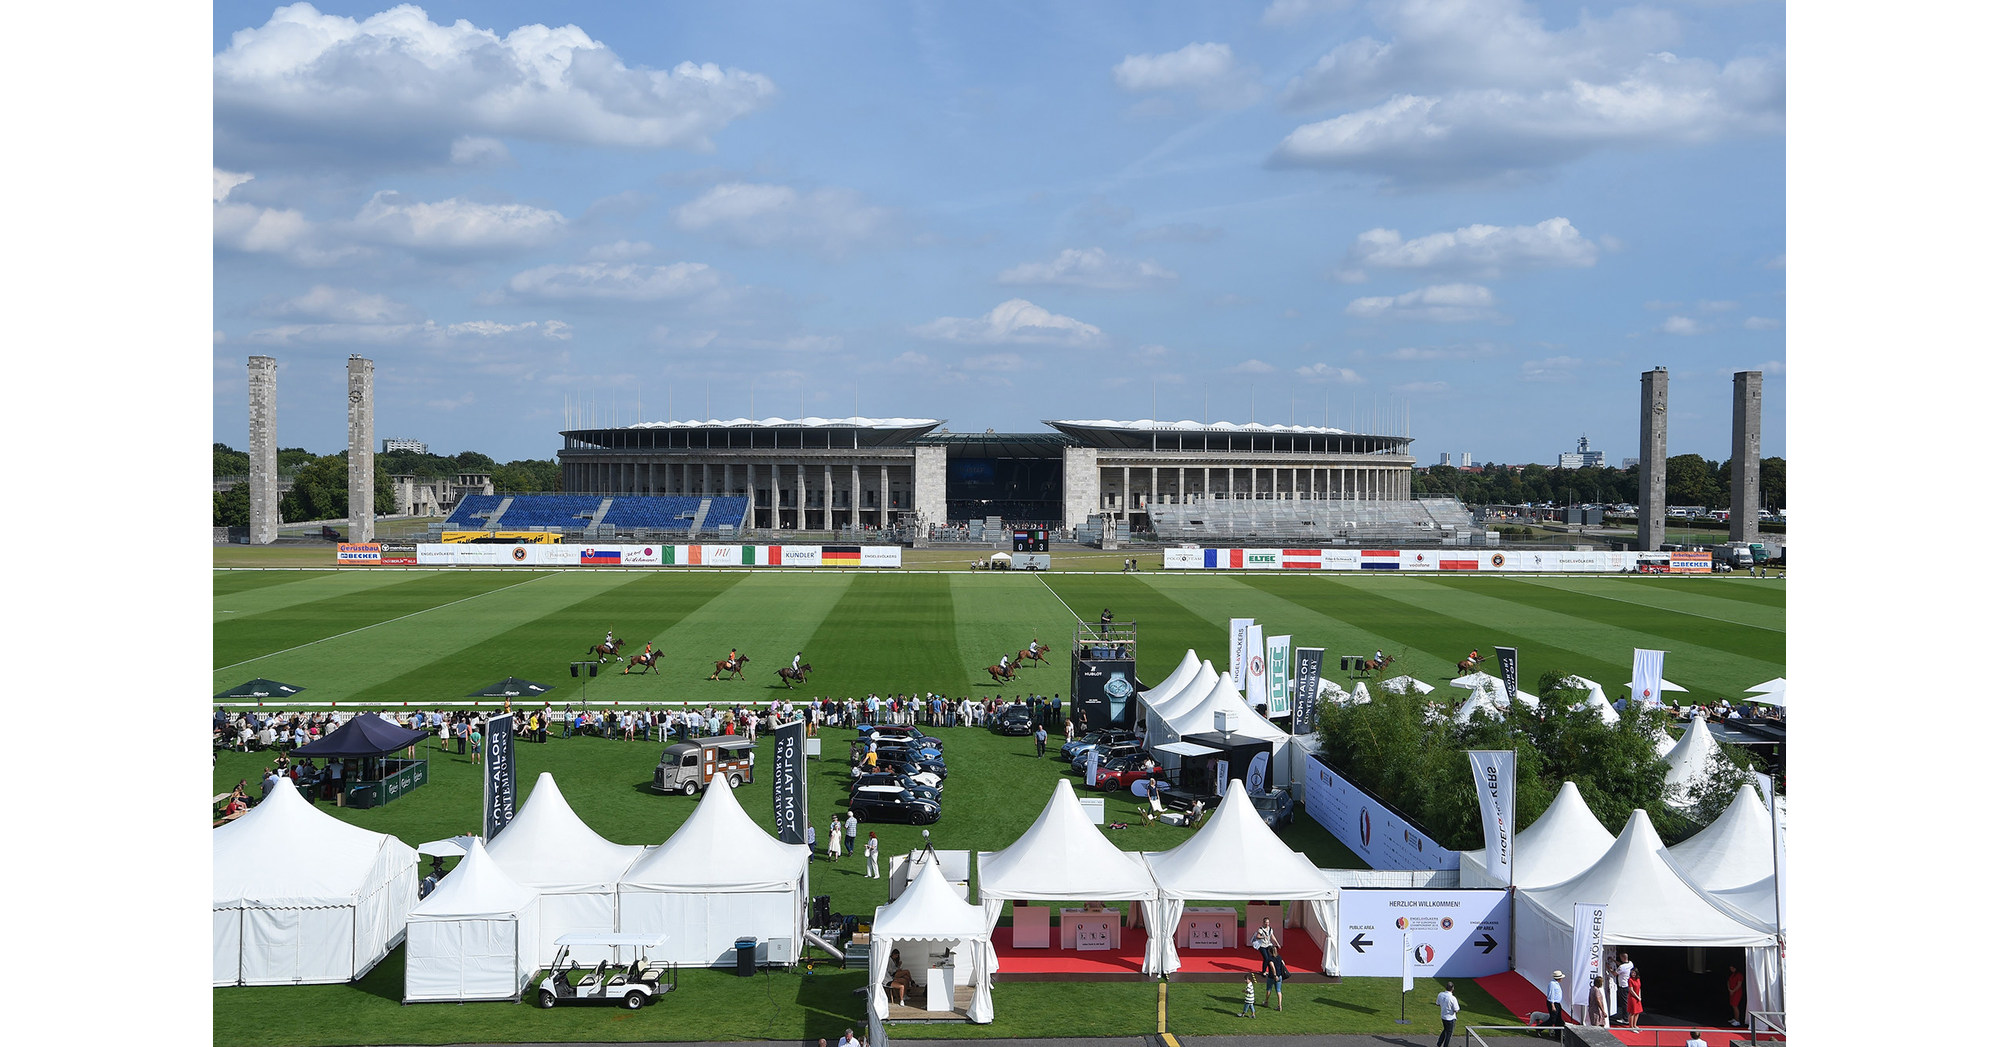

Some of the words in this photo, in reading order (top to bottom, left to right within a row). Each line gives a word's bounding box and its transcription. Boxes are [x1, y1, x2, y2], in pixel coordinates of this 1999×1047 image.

[1039, 543, 1044, 551] 3
[1272, 645, 1285, 712] ELTEC
[1296, 702, 1304, 725] TOM
[1300, 659, 1309, 699] TAILOR
[1304, 660, 1317, 725] CONTEMPORARY
[492, 732, 500, 793] TAILOR
